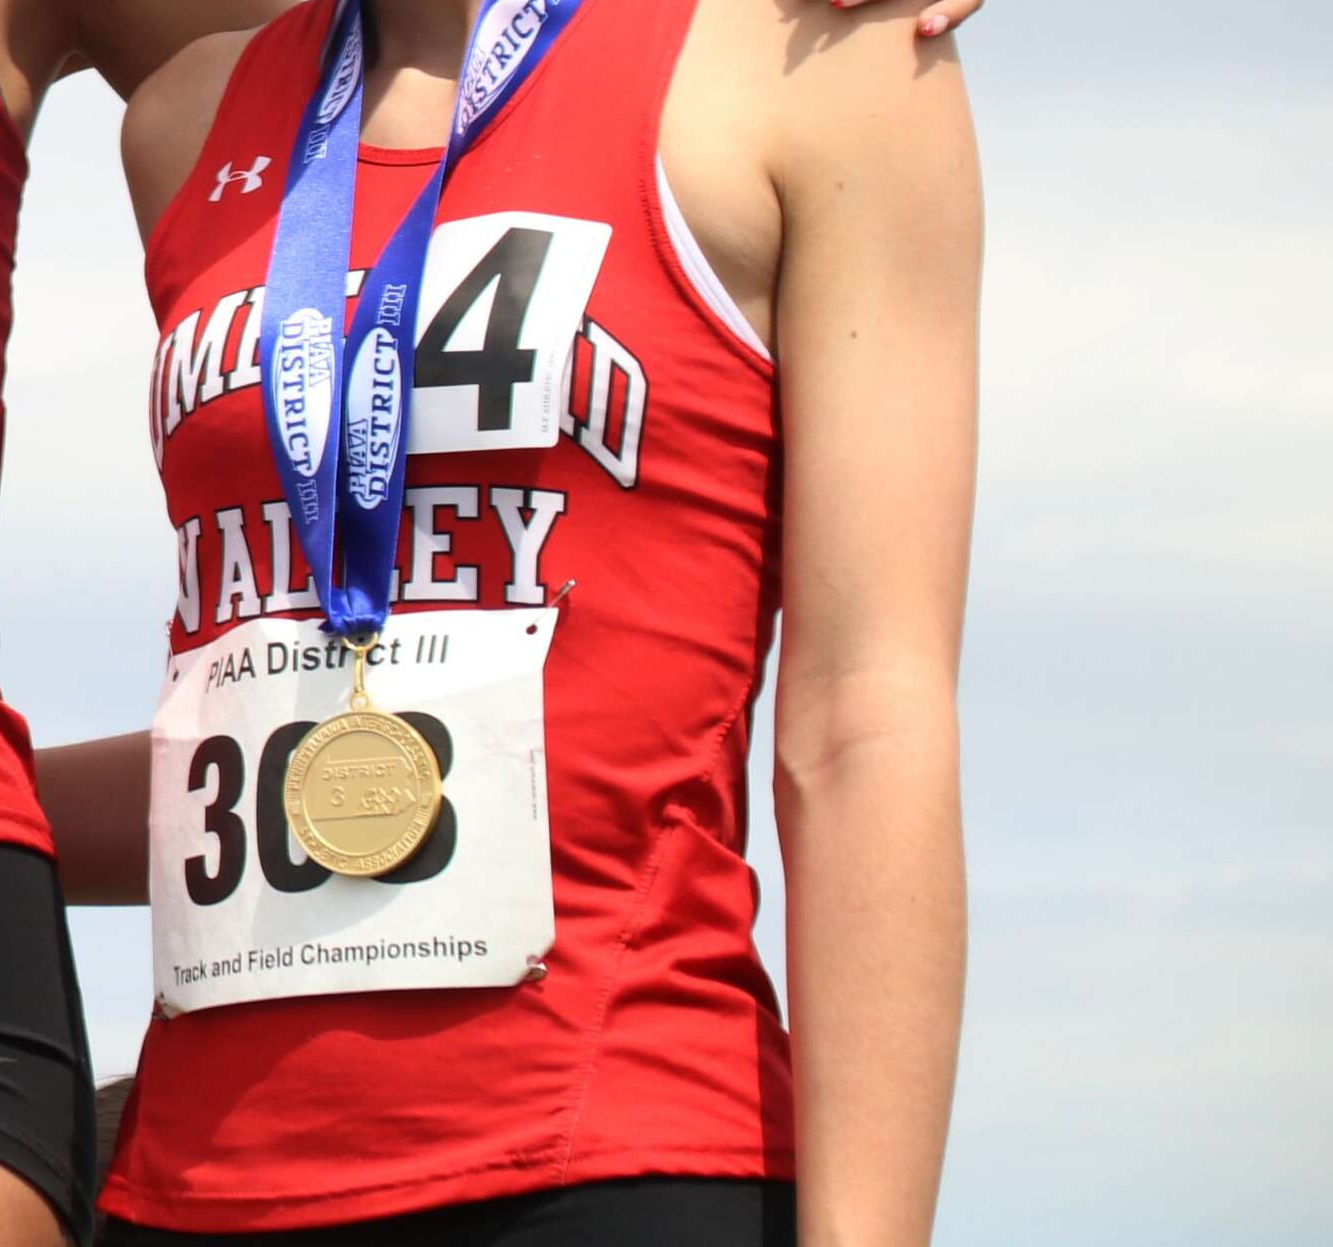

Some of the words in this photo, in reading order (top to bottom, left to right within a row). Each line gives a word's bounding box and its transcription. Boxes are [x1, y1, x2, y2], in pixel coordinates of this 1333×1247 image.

[279, 321, 313, 477] DISTRICT
[414, 226, 555, 432] 4
[368, 332, 398, 501] DISTRICT
[207, 647, 257, 693] PIAA
[268, 637, 402, 675] Distrct
[416, 635, 449, 664] III
[173, 964, 208, 987] Track
[212, 953, 242, 977] and
[248, 944, 294, 972] Field
[301, 936, 488, 965] Championships
